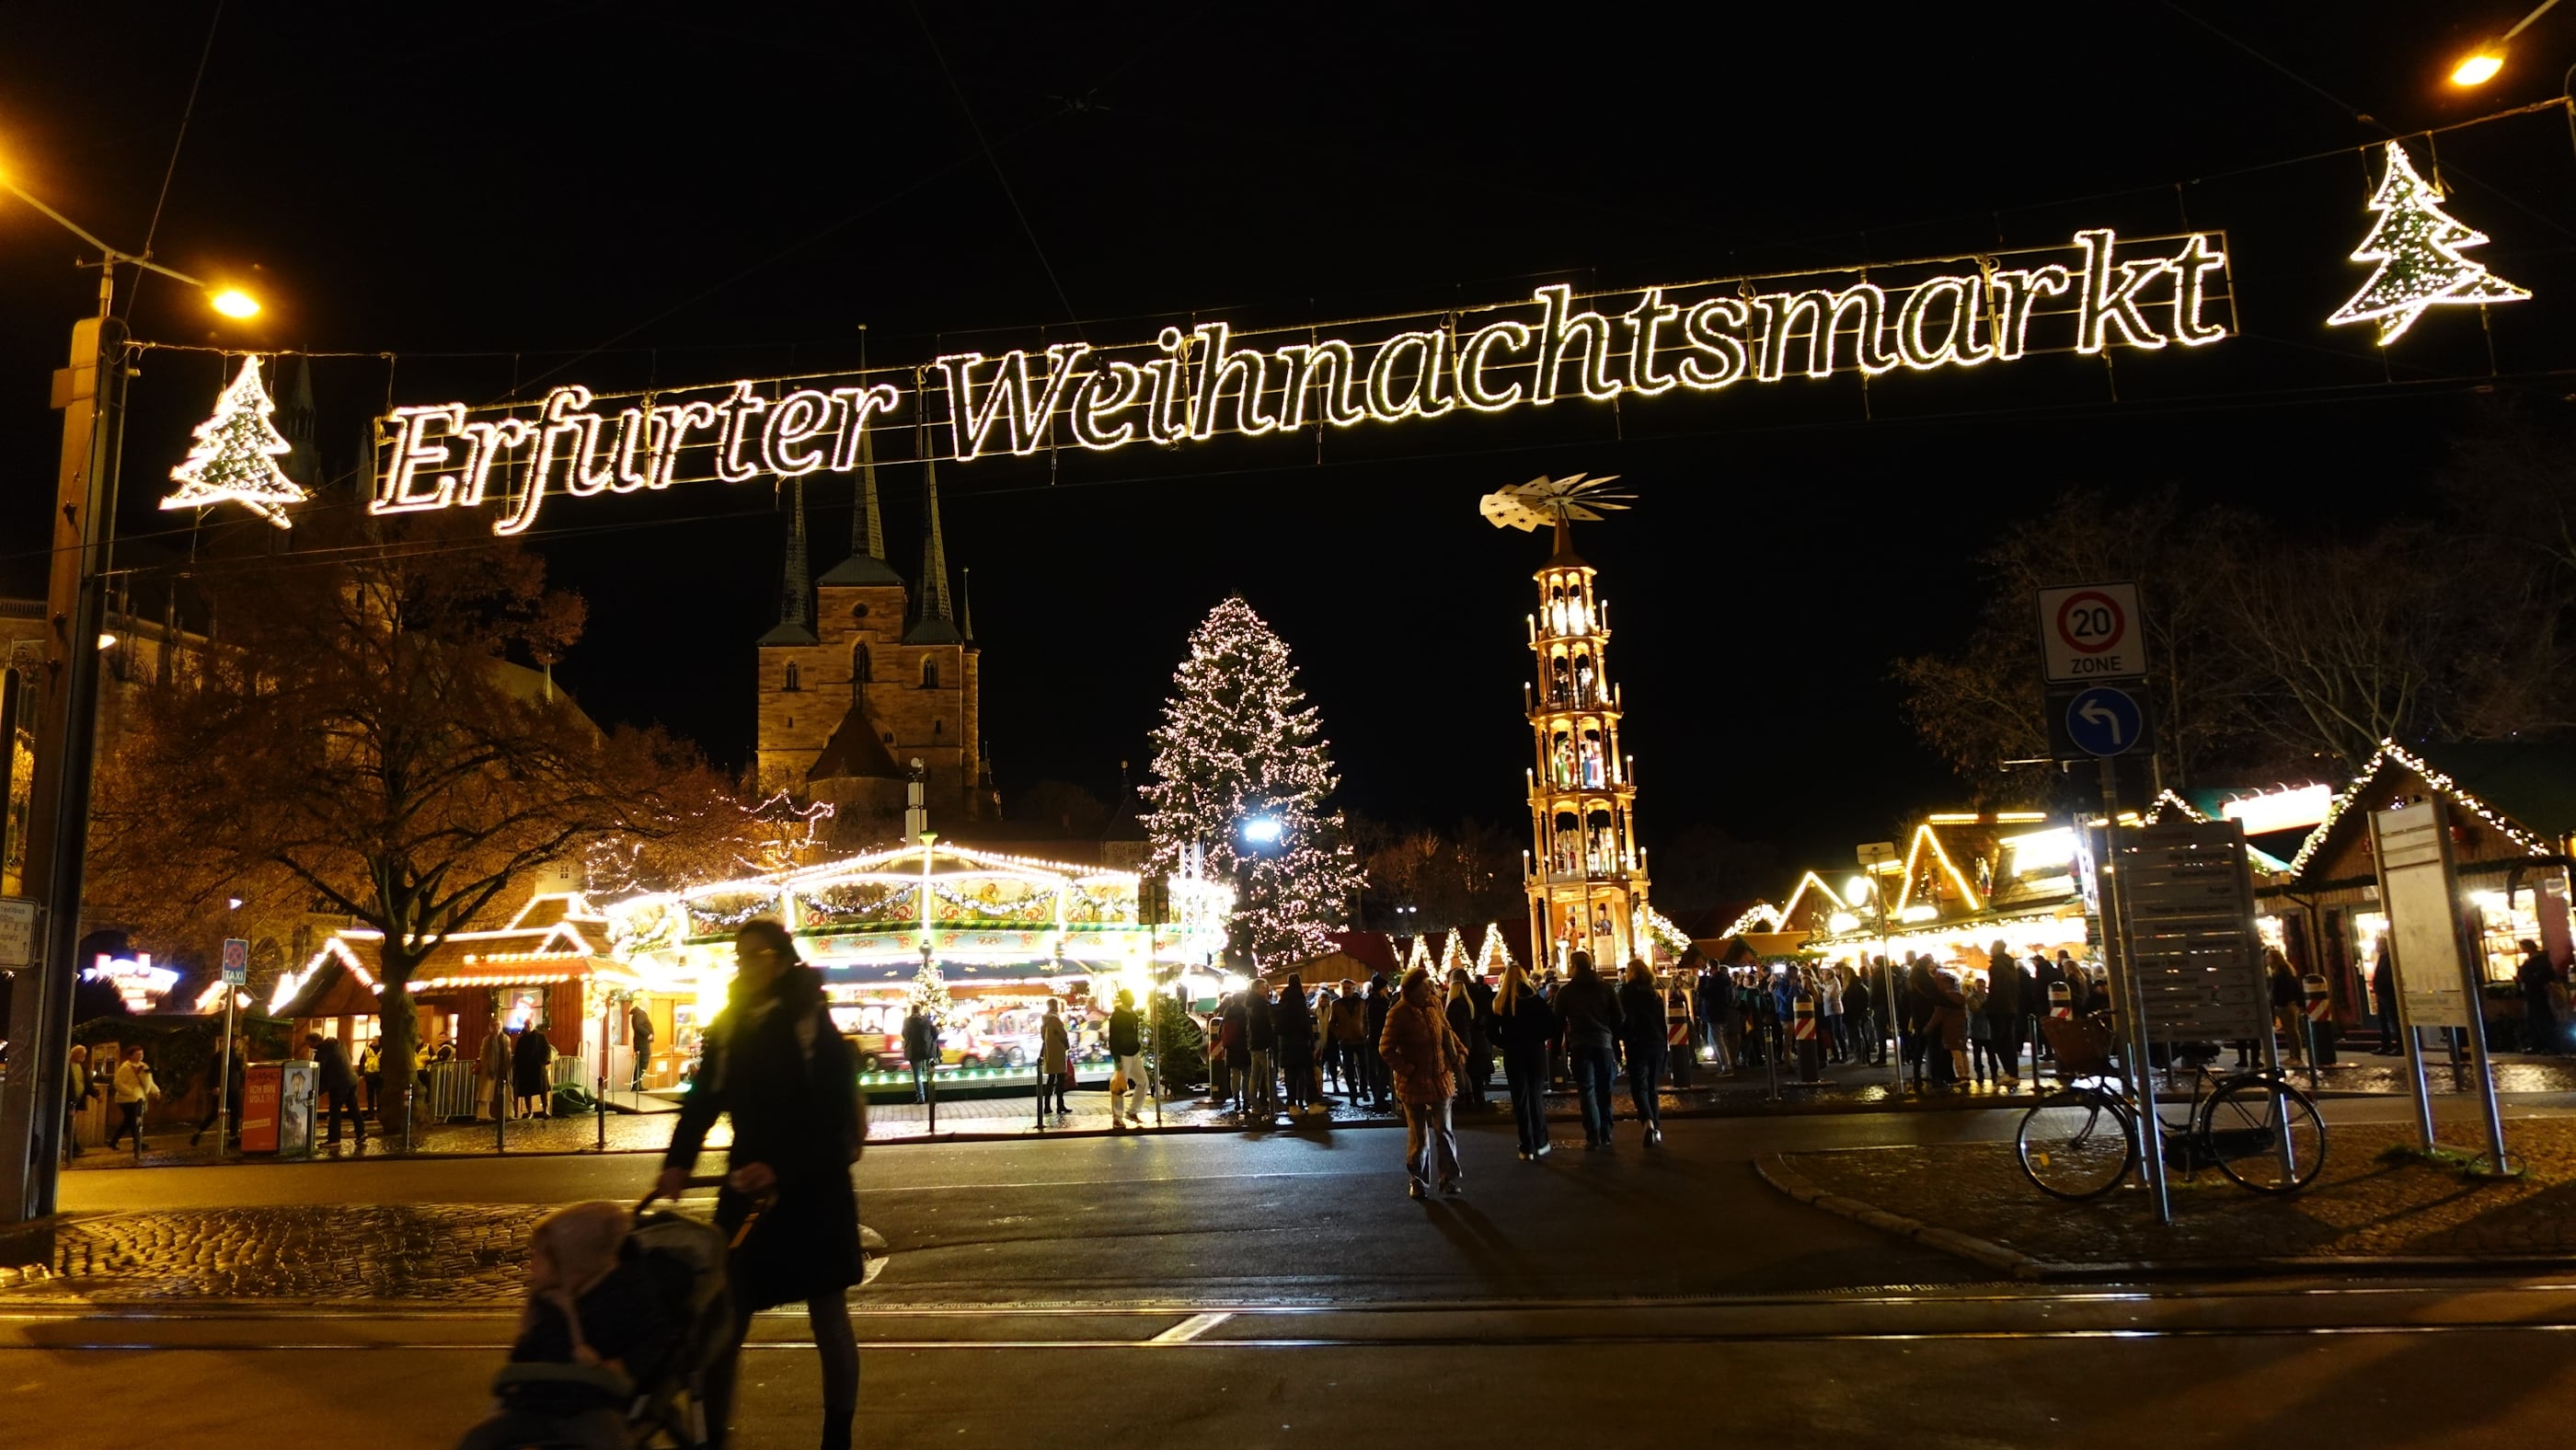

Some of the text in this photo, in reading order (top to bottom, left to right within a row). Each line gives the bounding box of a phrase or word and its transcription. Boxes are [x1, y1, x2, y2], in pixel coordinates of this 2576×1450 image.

[371, 228, 2226, 535] Erfurter Weihnachtsmarkt
[2072, 607, 2111, 638] 20
[2070, 655, 2122, 674] ZONE
[225, 970, 244, 981] TAXI
